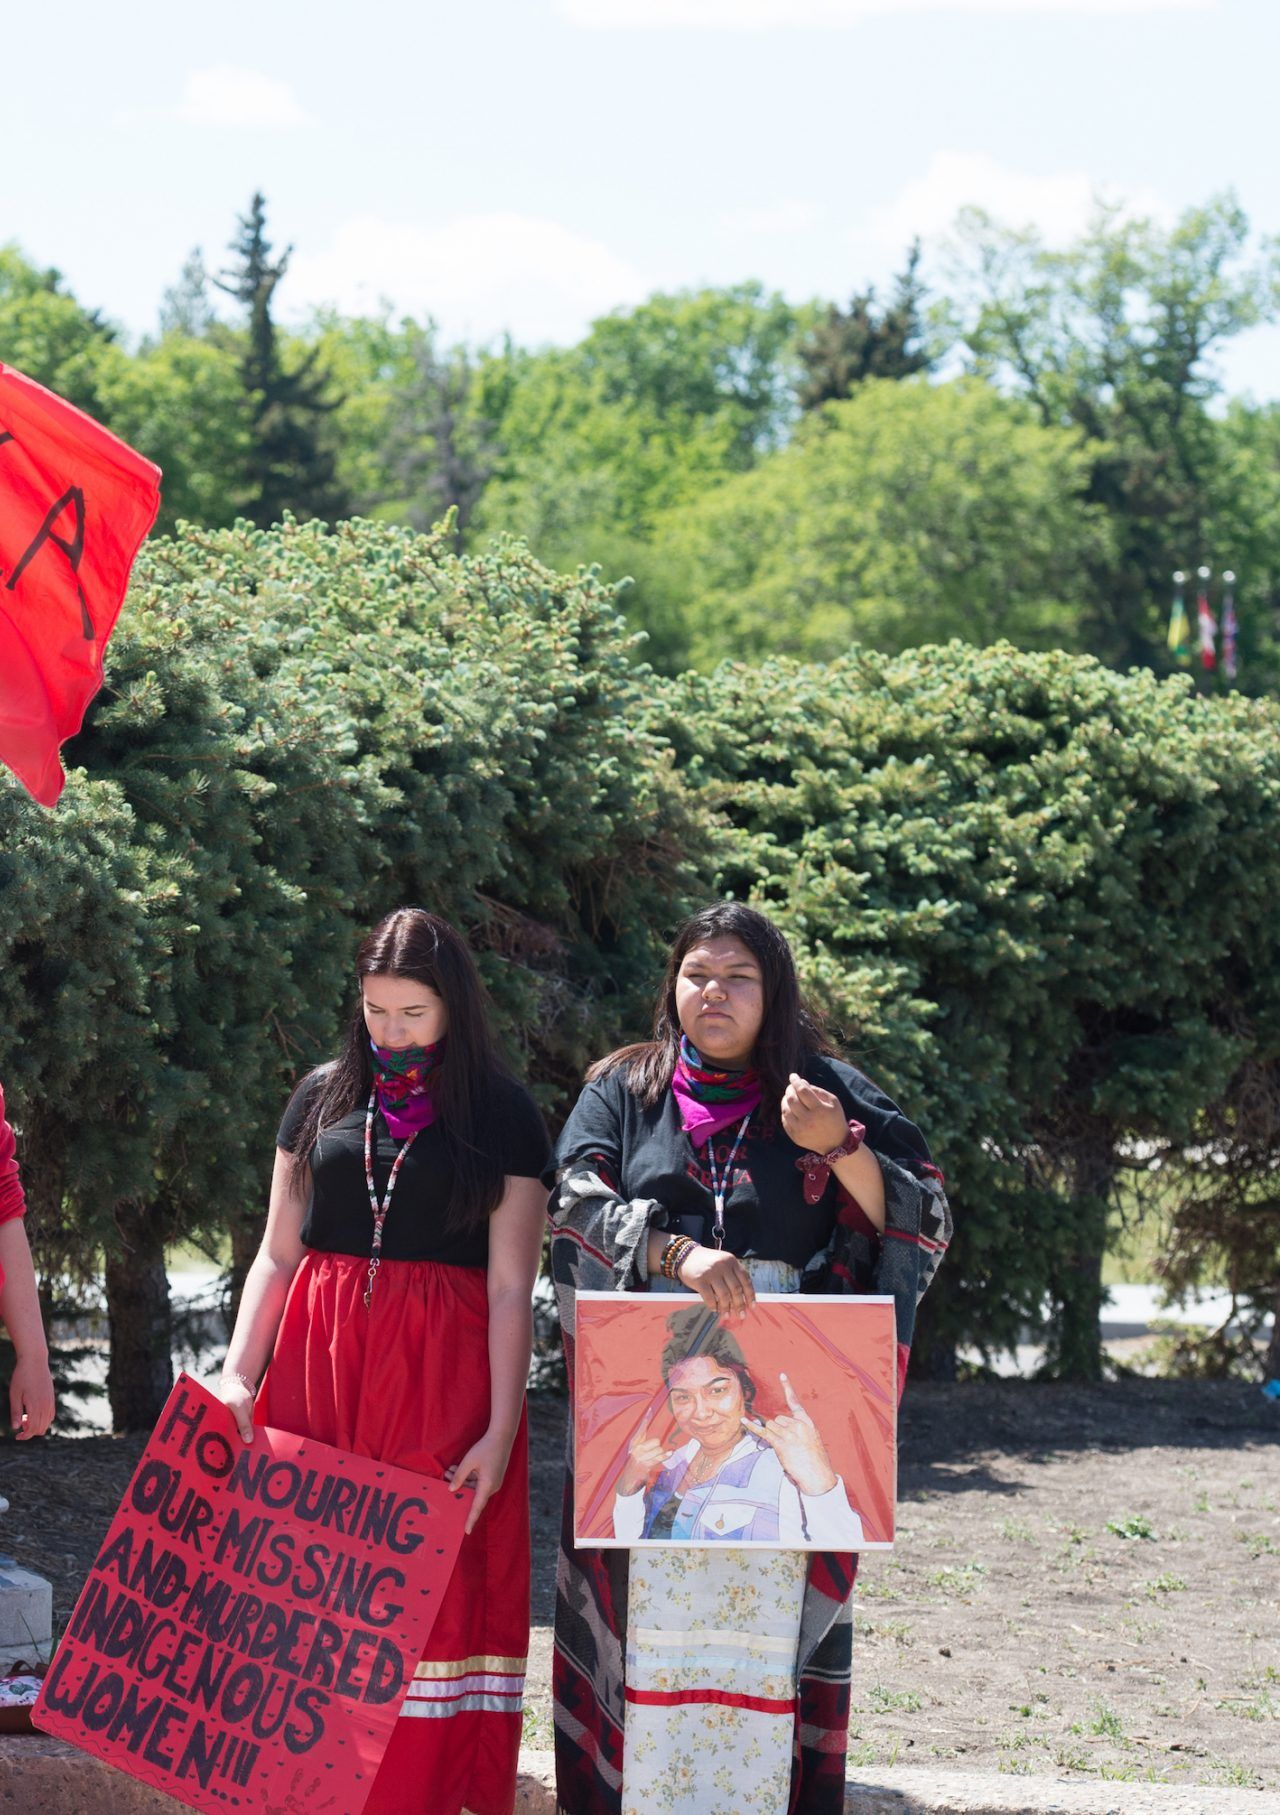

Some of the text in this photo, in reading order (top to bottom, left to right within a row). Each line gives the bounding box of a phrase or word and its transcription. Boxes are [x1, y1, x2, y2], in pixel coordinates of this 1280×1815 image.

[160, 1390, 429, 1555] HONOURING
[44, 1650, 261, 1806] WOMEN!!!
[70, 1579, 326, 1755] INDIGENOUS
